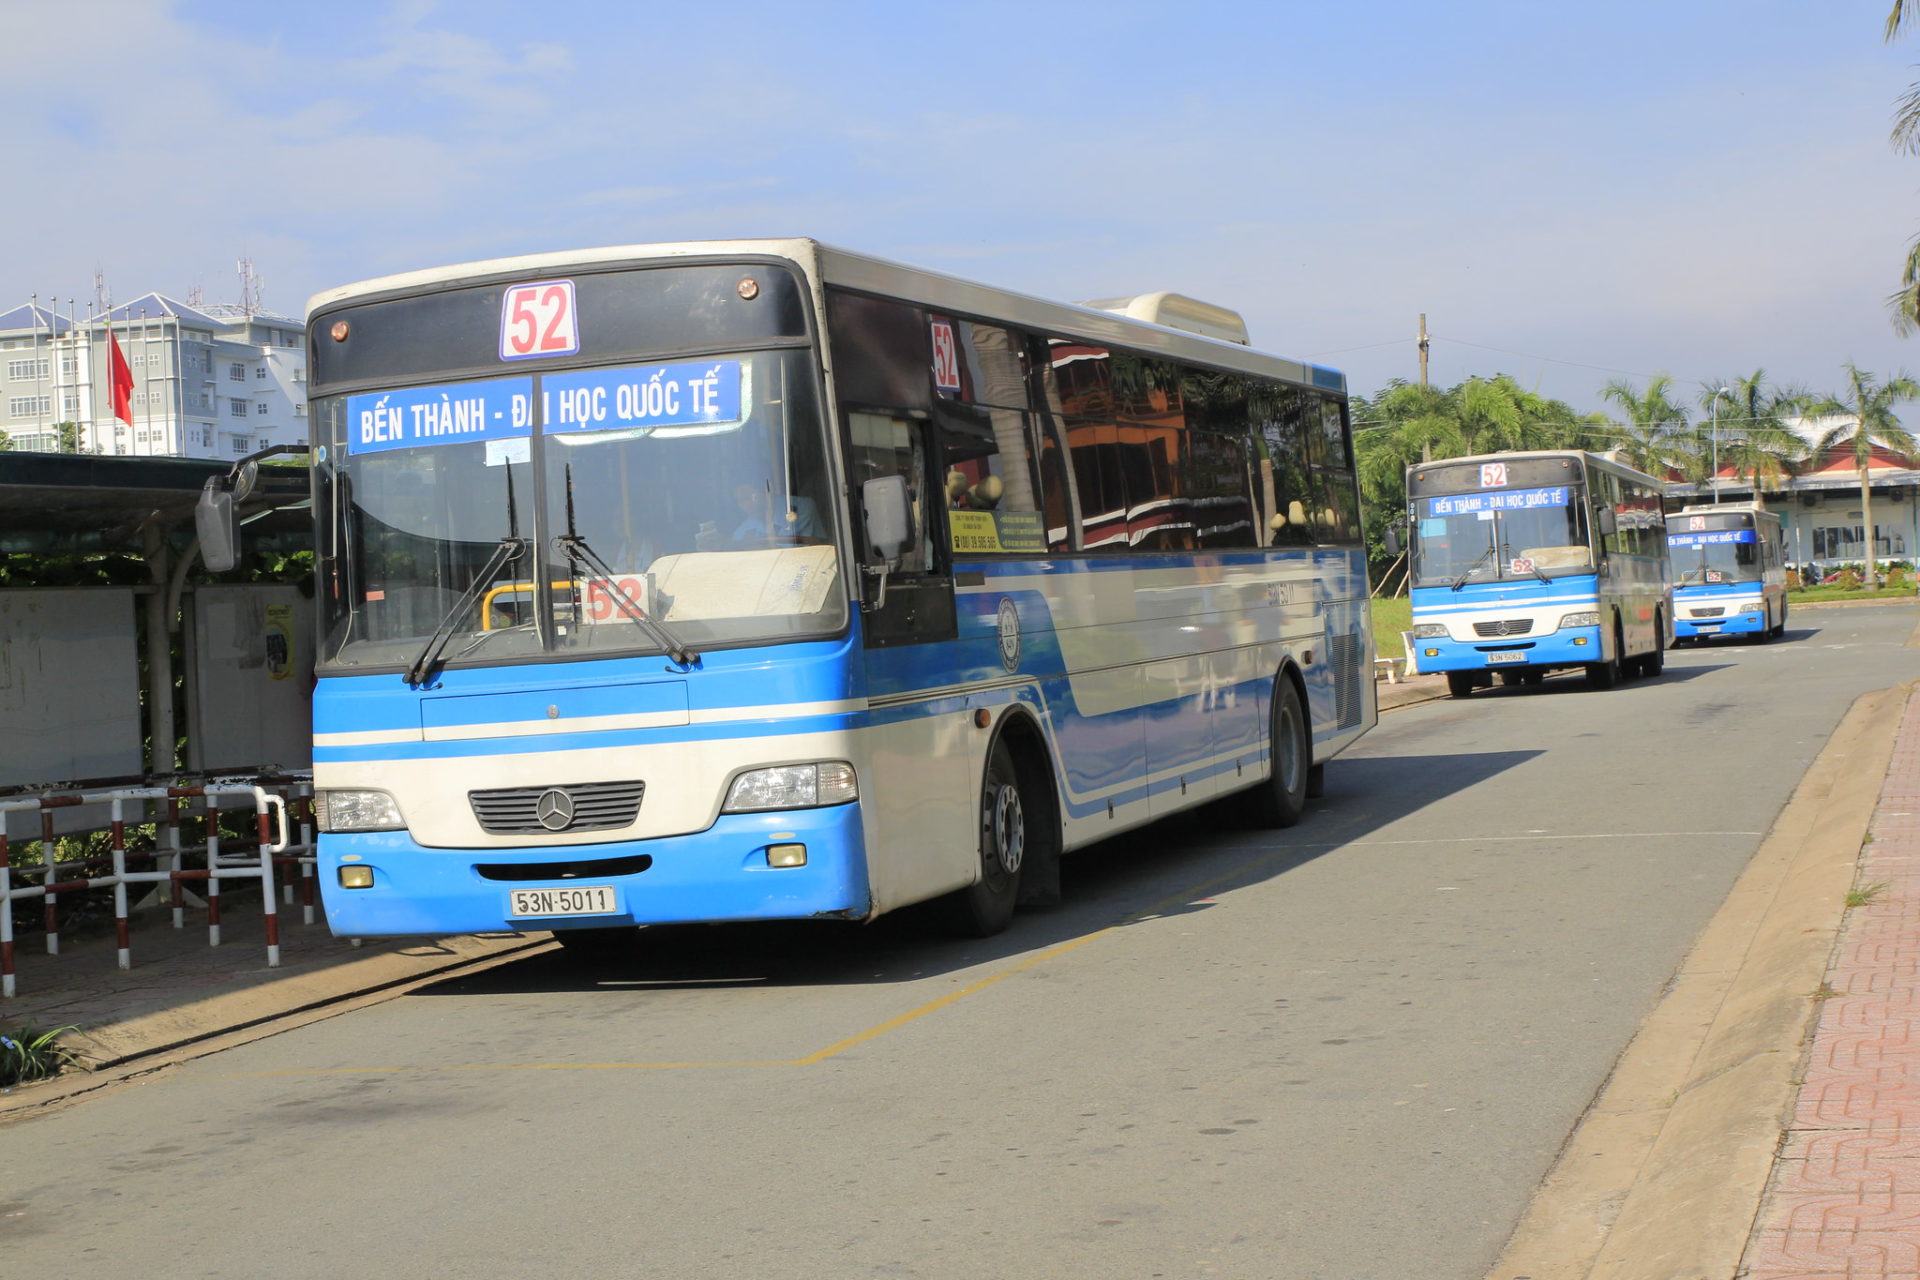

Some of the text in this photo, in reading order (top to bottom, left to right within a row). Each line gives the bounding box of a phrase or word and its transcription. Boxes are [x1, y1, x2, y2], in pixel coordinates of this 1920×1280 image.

[510, 285, 569, 353] 52
[932, 325, 959, 387] 52
[361, 395, 402, 445] BẾN
[412, 393, 486, 437] THÀNH
[559, 386, 607, 429] HỌC
[616, 369, 680, 422] QUỐC
[689, 364, 721, 415] TẾ
[1484, 464, 1505, 486] 52
[1691, 517, 1704, 530] 52
[1513, 559, 1533, 573] 52
[1708, 571, 1721, 581] 52
[586, 577, 645, 620] 52
[517, 889, 606, 913] 53N-5011
